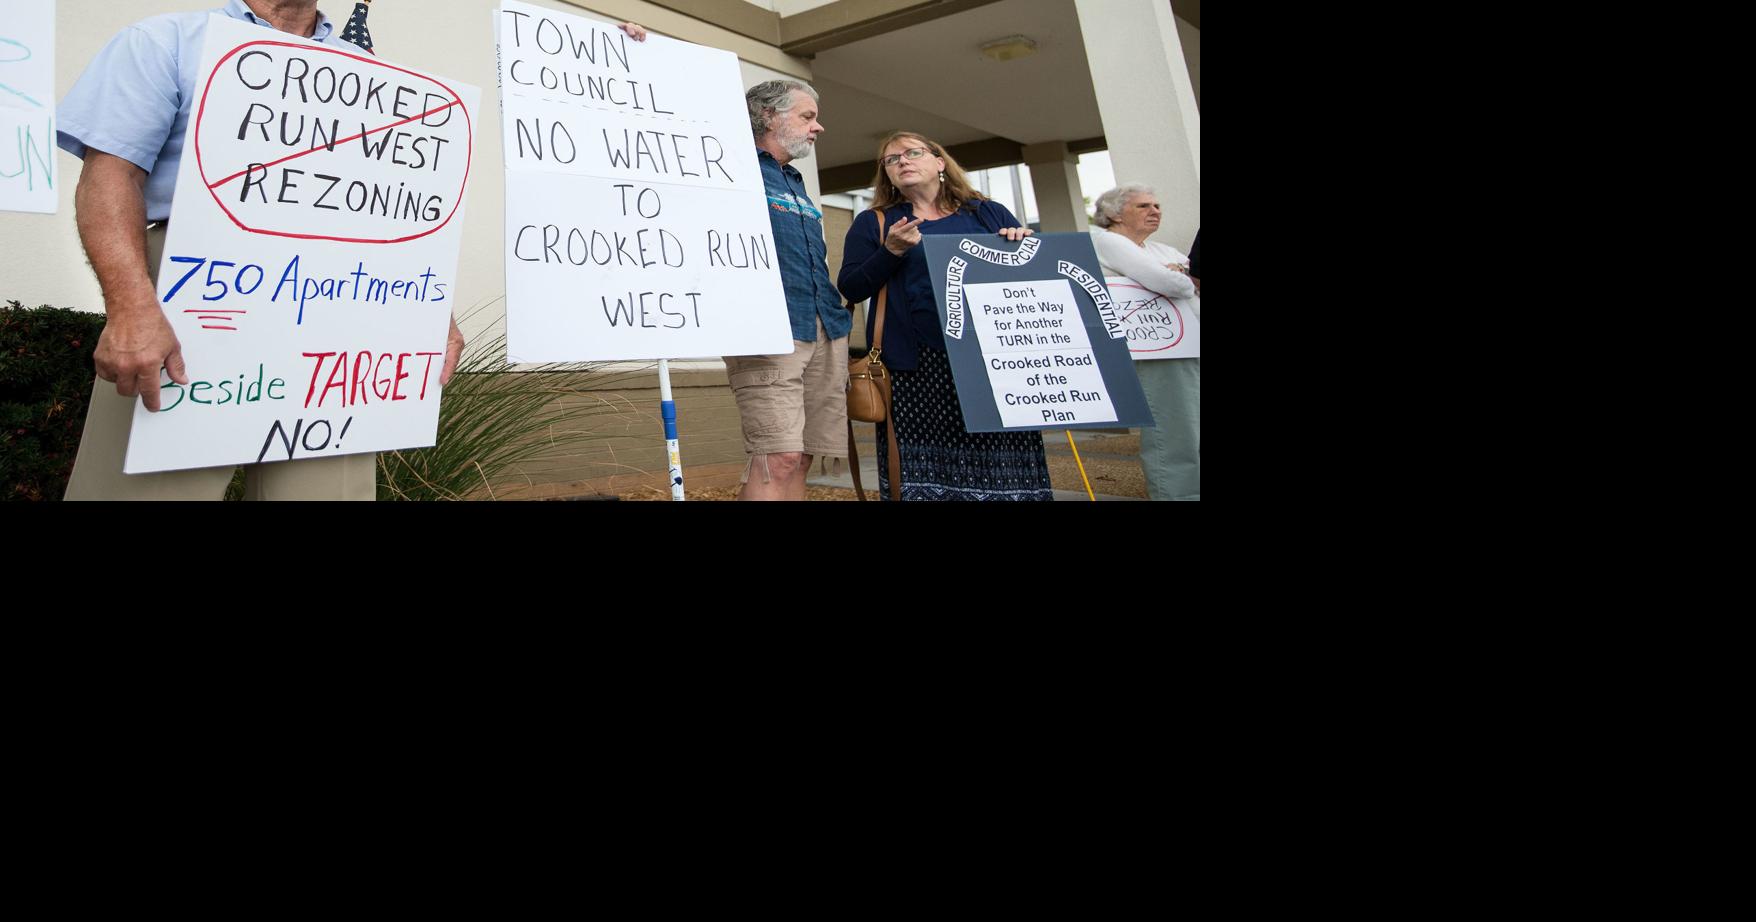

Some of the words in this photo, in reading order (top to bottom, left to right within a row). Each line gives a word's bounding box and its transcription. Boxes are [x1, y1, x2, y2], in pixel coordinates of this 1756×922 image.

[502, 10, 630, 72] TOWN
[236, 50, 453, 128] CROOKED
[510, 59, 674, 115] COUNCIL
[237, 102, 340, 152] RUN
[360, 122, 449, 172] WEST
[516, 118, 576, 164] NO
[603, 128, 734, 183] WATER
[613, 184, 661, 219] TO
[514, 224, 684, 269] CROOKED
[707, 229, 770, 270] RUN
[960, 238, 1040, 265] COMMERCIAL
[163, 256, 264, 303] 750
[271, 254, 447, 325] Apartments
[601, 291, 702, 329] WEST
[948, 257, 965, 338] AGRICULTURE
[984, 304, 1013, 316] Pave
[1016, 303, 1036, 313] the
[1037, 301, 1064, 315] Way
[1003, 287, 1036, 299] Don't
[1059, 262, 1124, 339] RESIDENTIAL
[994, 319, 1012, 330] for
[1015, 317, 1063, 330] Another
[996, 334, 1033, 347] TURN
[1036, 333, 1048, 345] in
[1051, 333, 1071, 344] the
[302, 350, 442, 408] TARGET
[991, 356, 1051, 371] Crooked
[1055, 354, 1092, 368] Road
[1026, 374, 1041, 387] of
[1044, 373, 1068, 386] the
[1004, 391, 1067, 406] Crooked
[1070, 390, 1101, 403] Run
[1042, 409, 1076, 422] Plan
[256, 416, 353, 463] NO!
